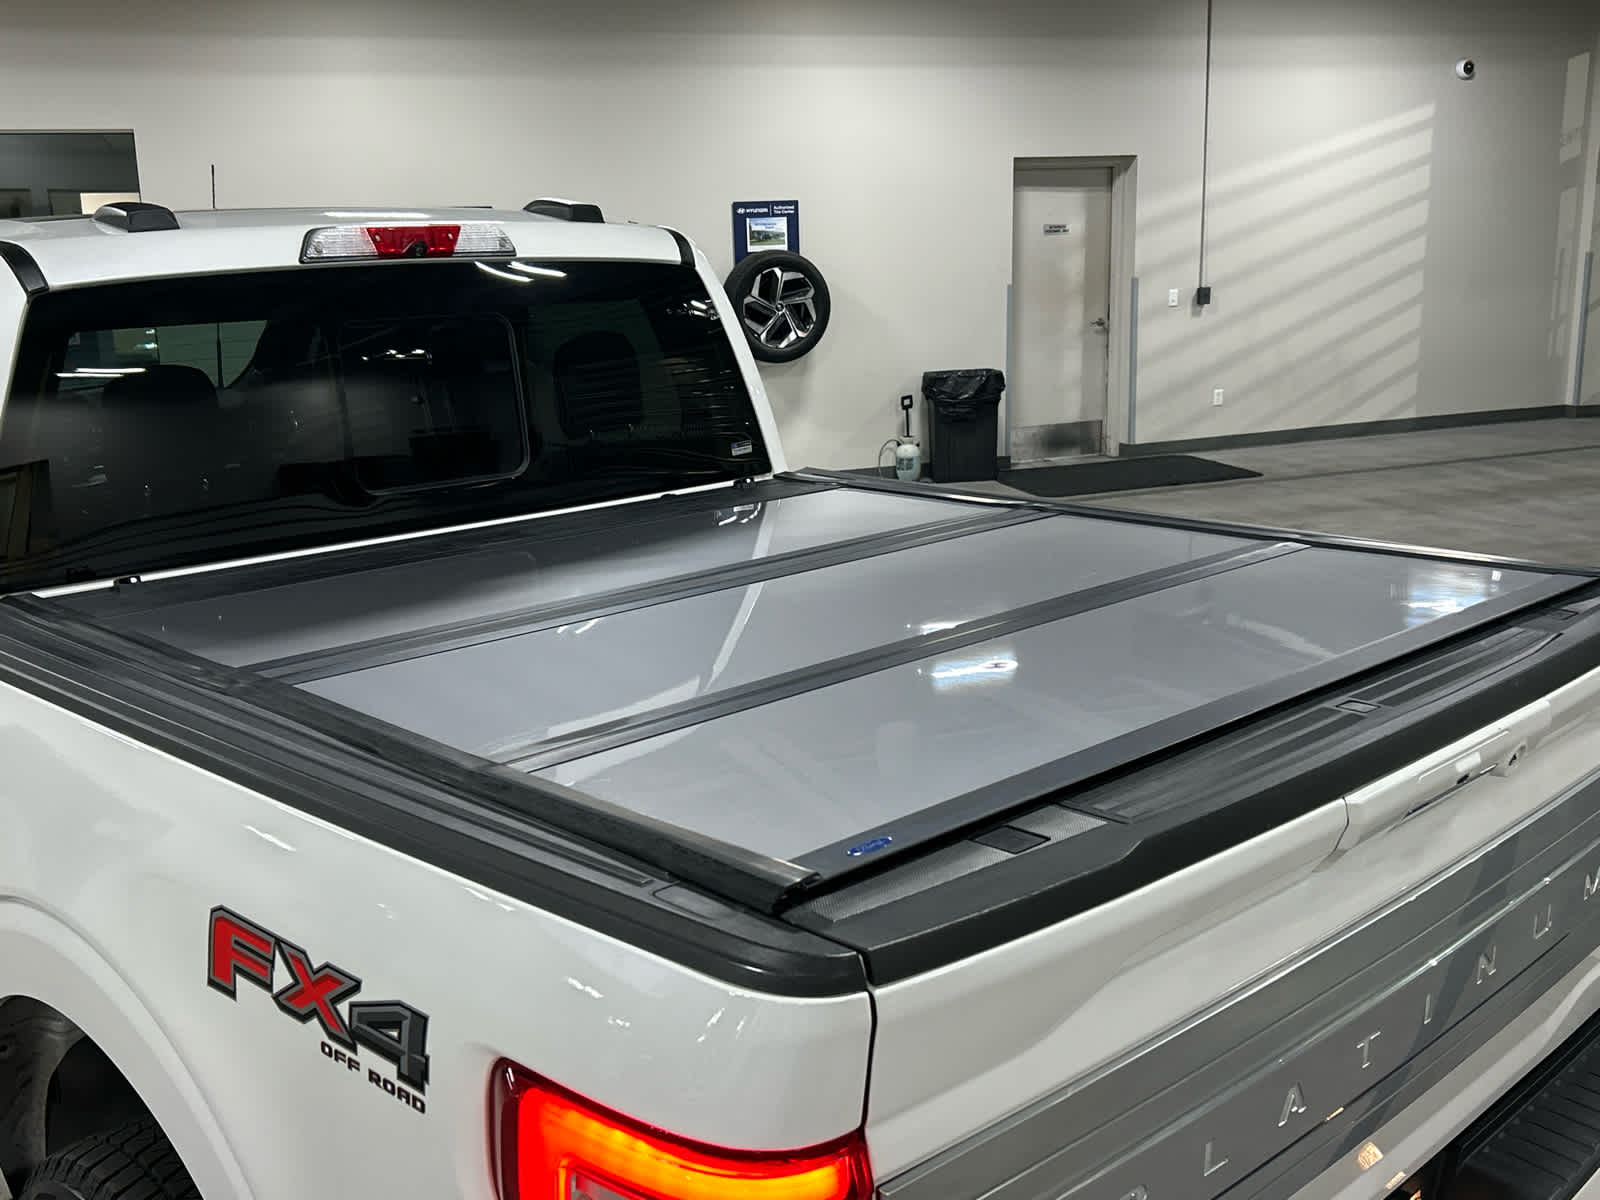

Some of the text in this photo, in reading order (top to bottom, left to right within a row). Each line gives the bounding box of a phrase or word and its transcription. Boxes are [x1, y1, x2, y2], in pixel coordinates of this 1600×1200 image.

[207, 904, 430, 1096] FX4
[320, 1040, 426, 1114] OFF ROAD
